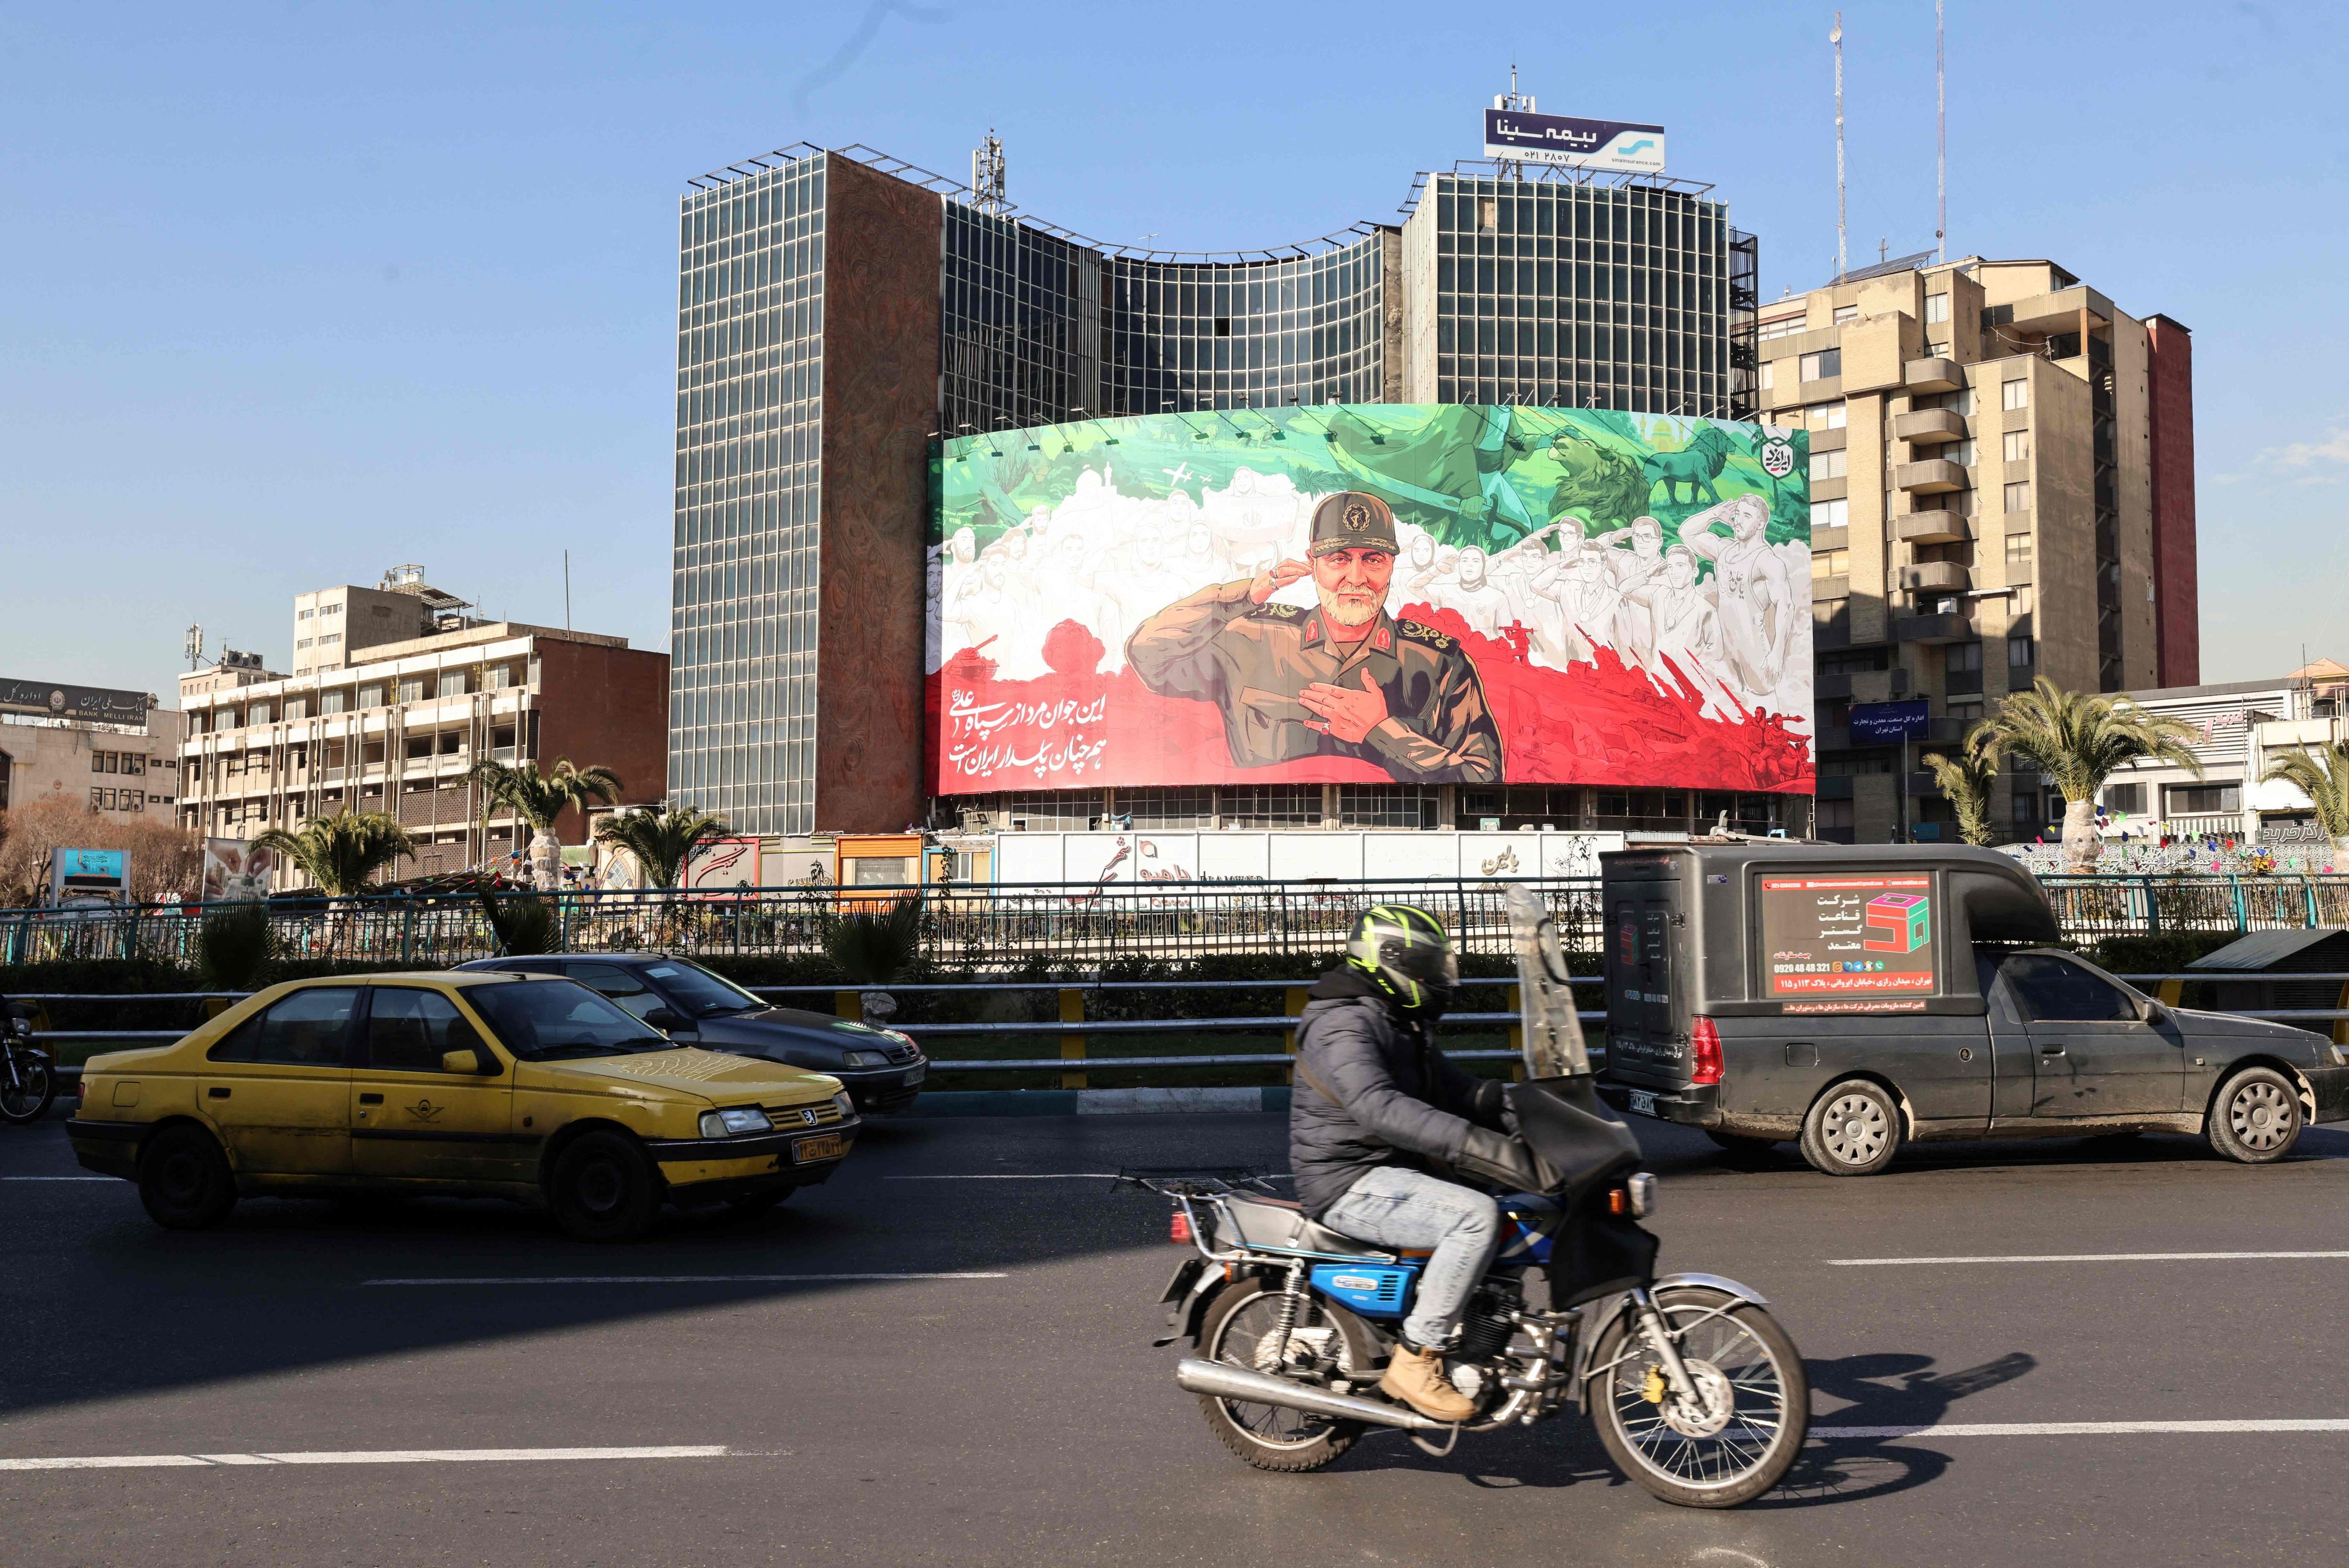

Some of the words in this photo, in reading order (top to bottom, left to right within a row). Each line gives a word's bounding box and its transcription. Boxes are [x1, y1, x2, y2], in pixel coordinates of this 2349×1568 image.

[1497, 119, 1543, 140] سینا
[1546, 127, 1596, 148] بیمه
[1544, 153, 1570, 162] ۲۸۰۷
[1611, 157, 1661, 166] sinainsurance.com
[4, 682, 21, 702] کل
[20, 692, 41, 700] اداره
[80, 695, 101, 710] ایران
[112, 695, 148, 714] بانک
[1076, 692, 1106, 724] این
[949, 743, 978, 773] است
[964, 744, 999, 777] ایران
[995, 739, 1054, 779] پاسدار
[2263, 822, 2301, 844] خرید
[1482, 844, 1518, 875] بالین
[1817, 894, 1860, 907] شرکت
[1819, 910, 1860, 921] قناعت
[1819, 924, 1863, 938] گستر
[1828, 941, 1861, 950] معتمد
[1773, 951, 1798, 960] سفارشات
[1774, 964, 1794, 973] 0920
[1795, 964, 1805, 973] 48
[1806, 963, 1816, 972] 48
[1816, 963, 1830, 972] 321
[1811, 979, 1826, 988] پلاک
[1853, 978, 1873, 987] خیابان
[1893, 977, 1910, 986] میدان
